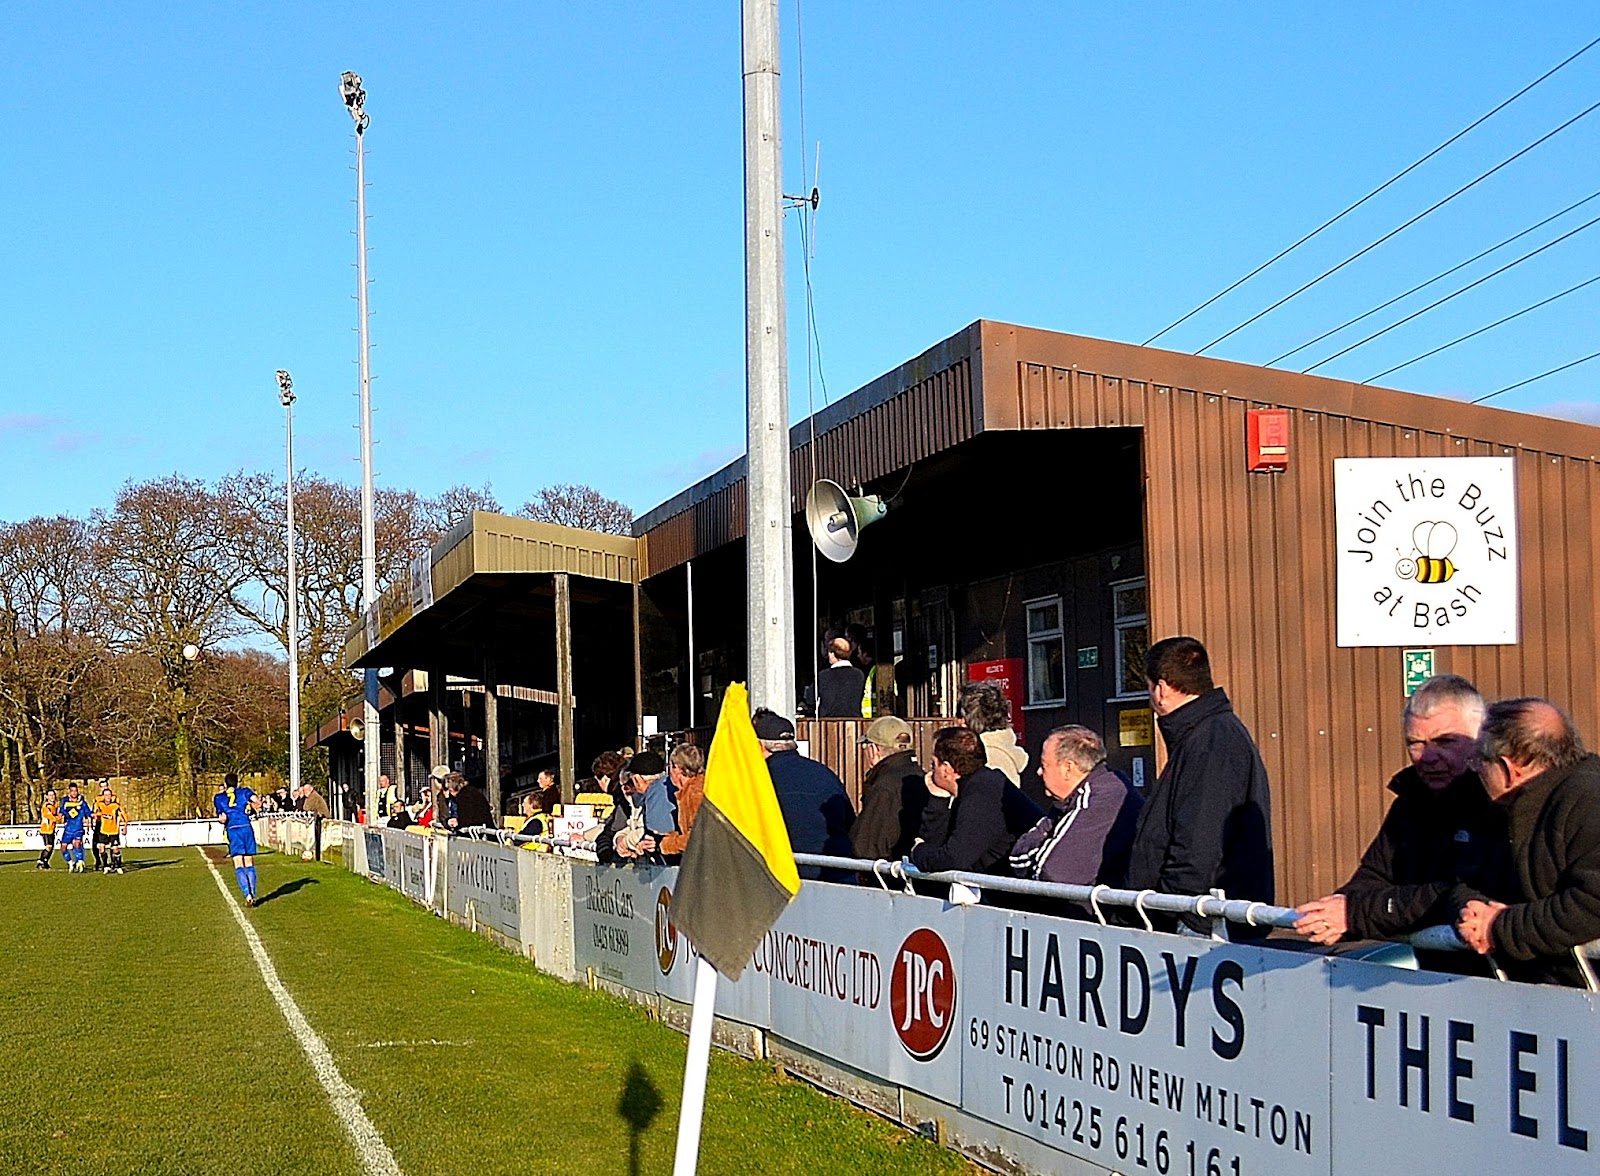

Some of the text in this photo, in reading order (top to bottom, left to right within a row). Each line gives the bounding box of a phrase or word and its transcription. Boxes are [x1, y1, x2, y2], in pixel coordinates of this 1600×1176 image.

[1347, 473, 1507, 563] Join the Buzz
[1373, 584, 1482, 628] at Bash
[567, 821, 584, 830] NO
[852, 949, 881, 1009] LTD
[901, 950, 944, 1032] JPC
[1005, 926, 1245, 1060] HARDYS
[970, 1017, 1312, 1154] 69 STATION RD NEW MILTON
[1357, 1004, 1475, 1124] THE
[1002, 1075, 1014, 1114] T
[1024, 1083, 1102, 1149] 01425
[1116, 1116, 1170, 1175] 616
